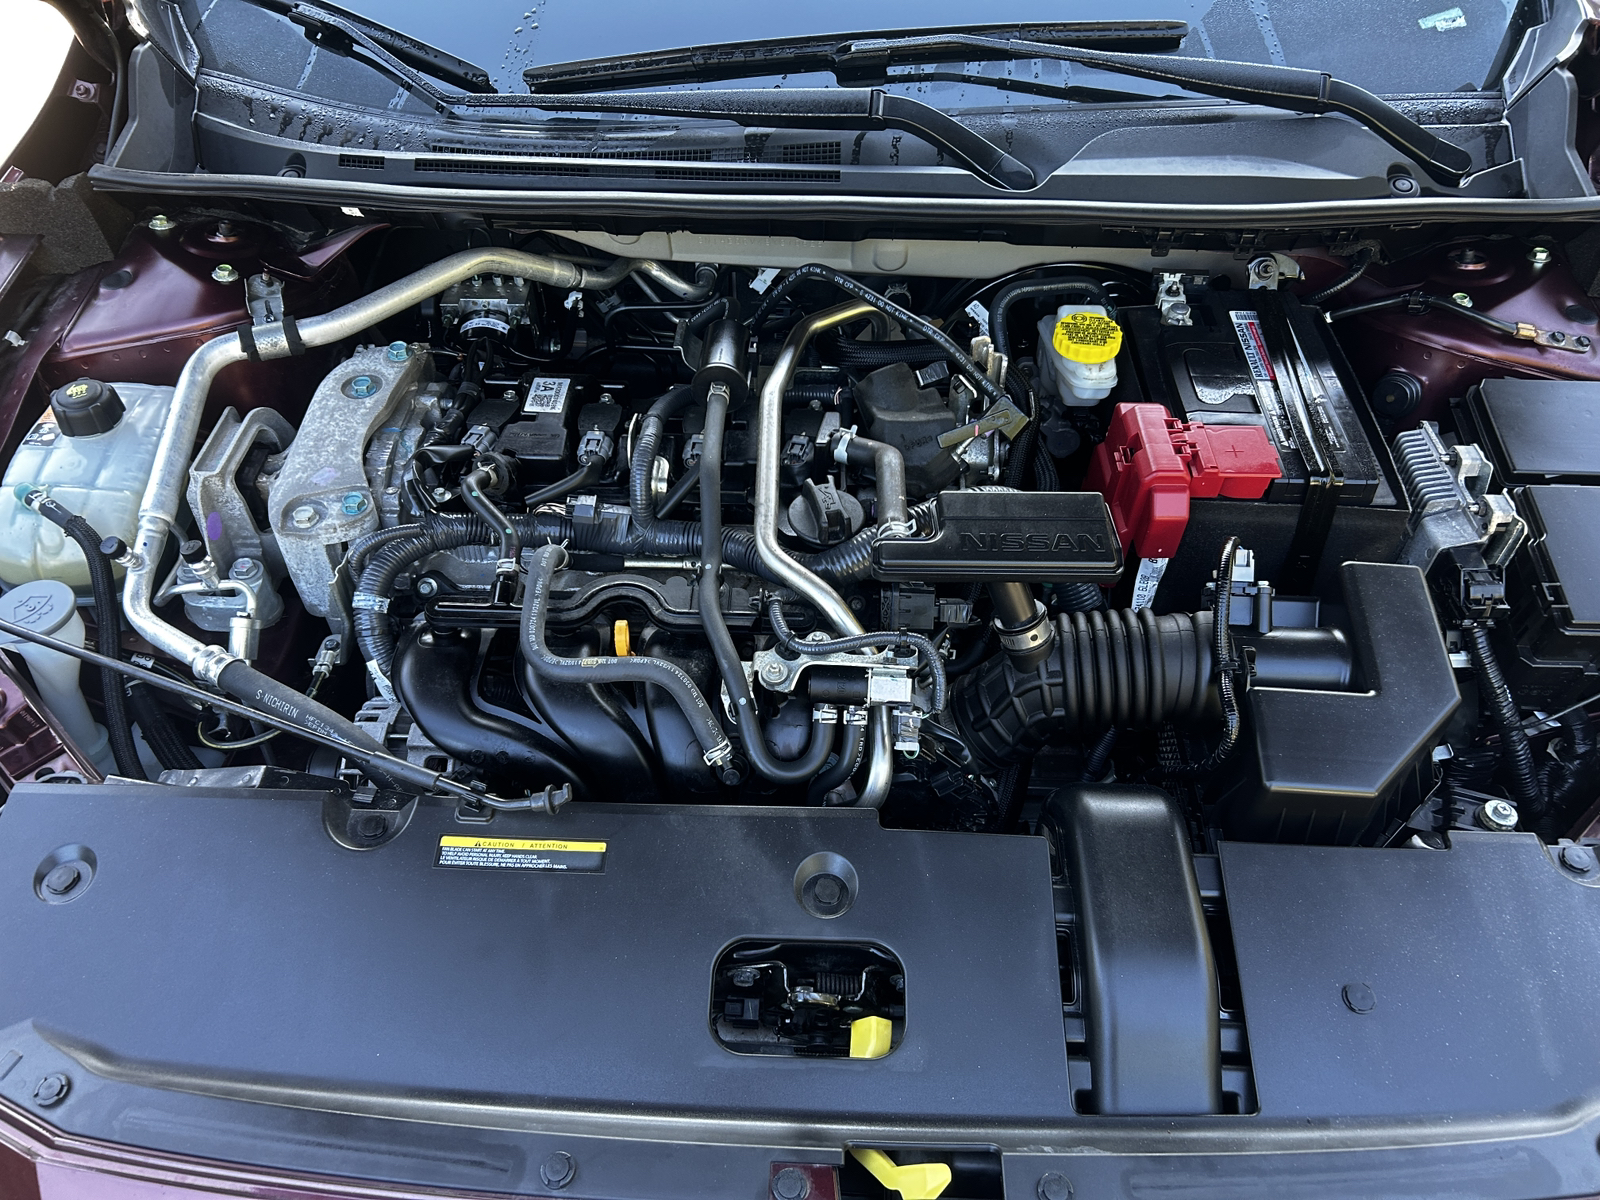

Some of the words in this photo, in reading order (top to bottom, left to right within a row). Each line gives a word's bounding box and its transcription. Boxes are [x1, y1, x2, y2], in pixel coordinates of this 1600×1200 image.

[885, 304, 894, 313] NOT
[895, 310, 909, 321] KINK
[1235, 322, 1252, 350] NISSAN
[1246, 351, 1263, 378] RENAULT
[540, 381, 556, 392] 3A
[982, 379, 995, 392] KINK
[960, 532, 1106, 552] NISSAN
